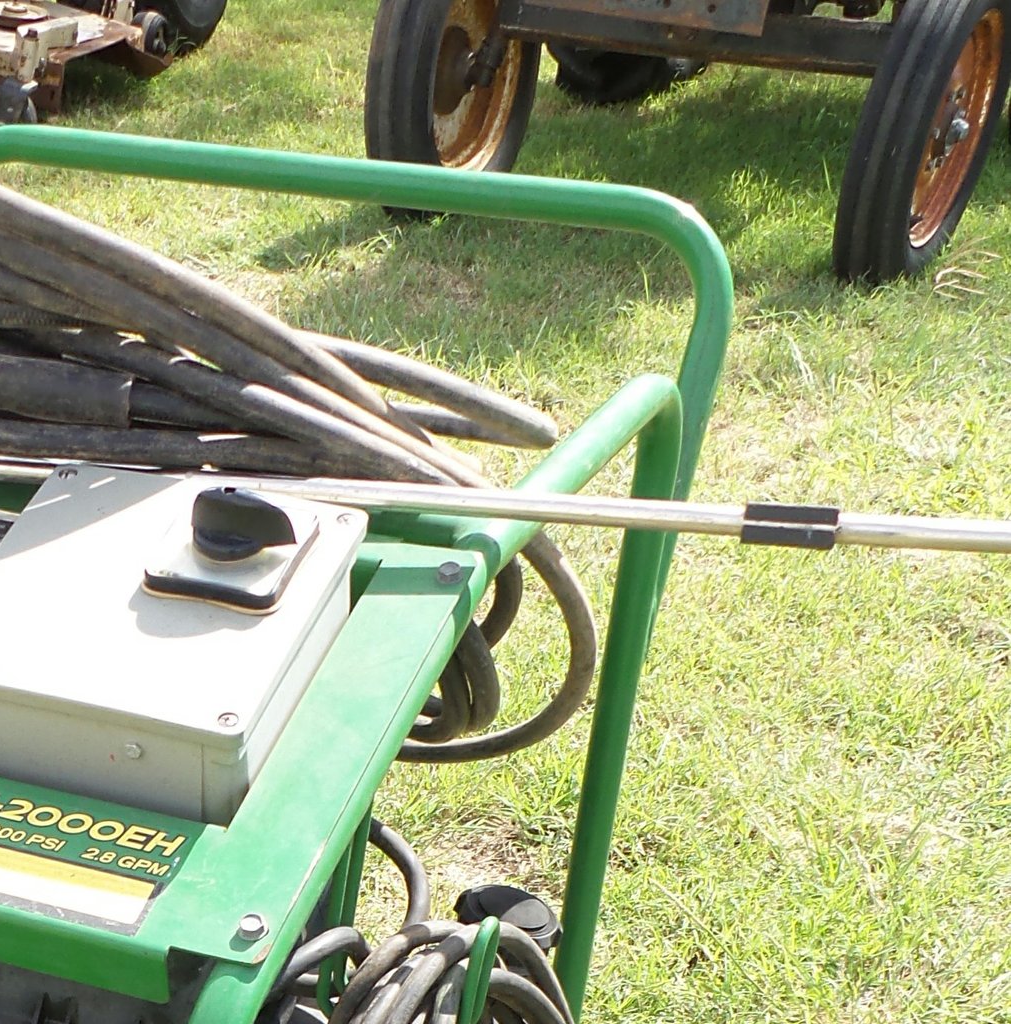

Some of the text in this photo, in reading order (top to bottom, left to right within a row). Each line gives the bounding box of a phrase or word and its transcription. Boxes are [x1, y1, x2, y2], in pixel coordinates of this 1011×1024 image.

[28, 833, 66, 853] PSI
[81, 847, 116, 864] 2.8
[117, 855, 172, 877] GPM
